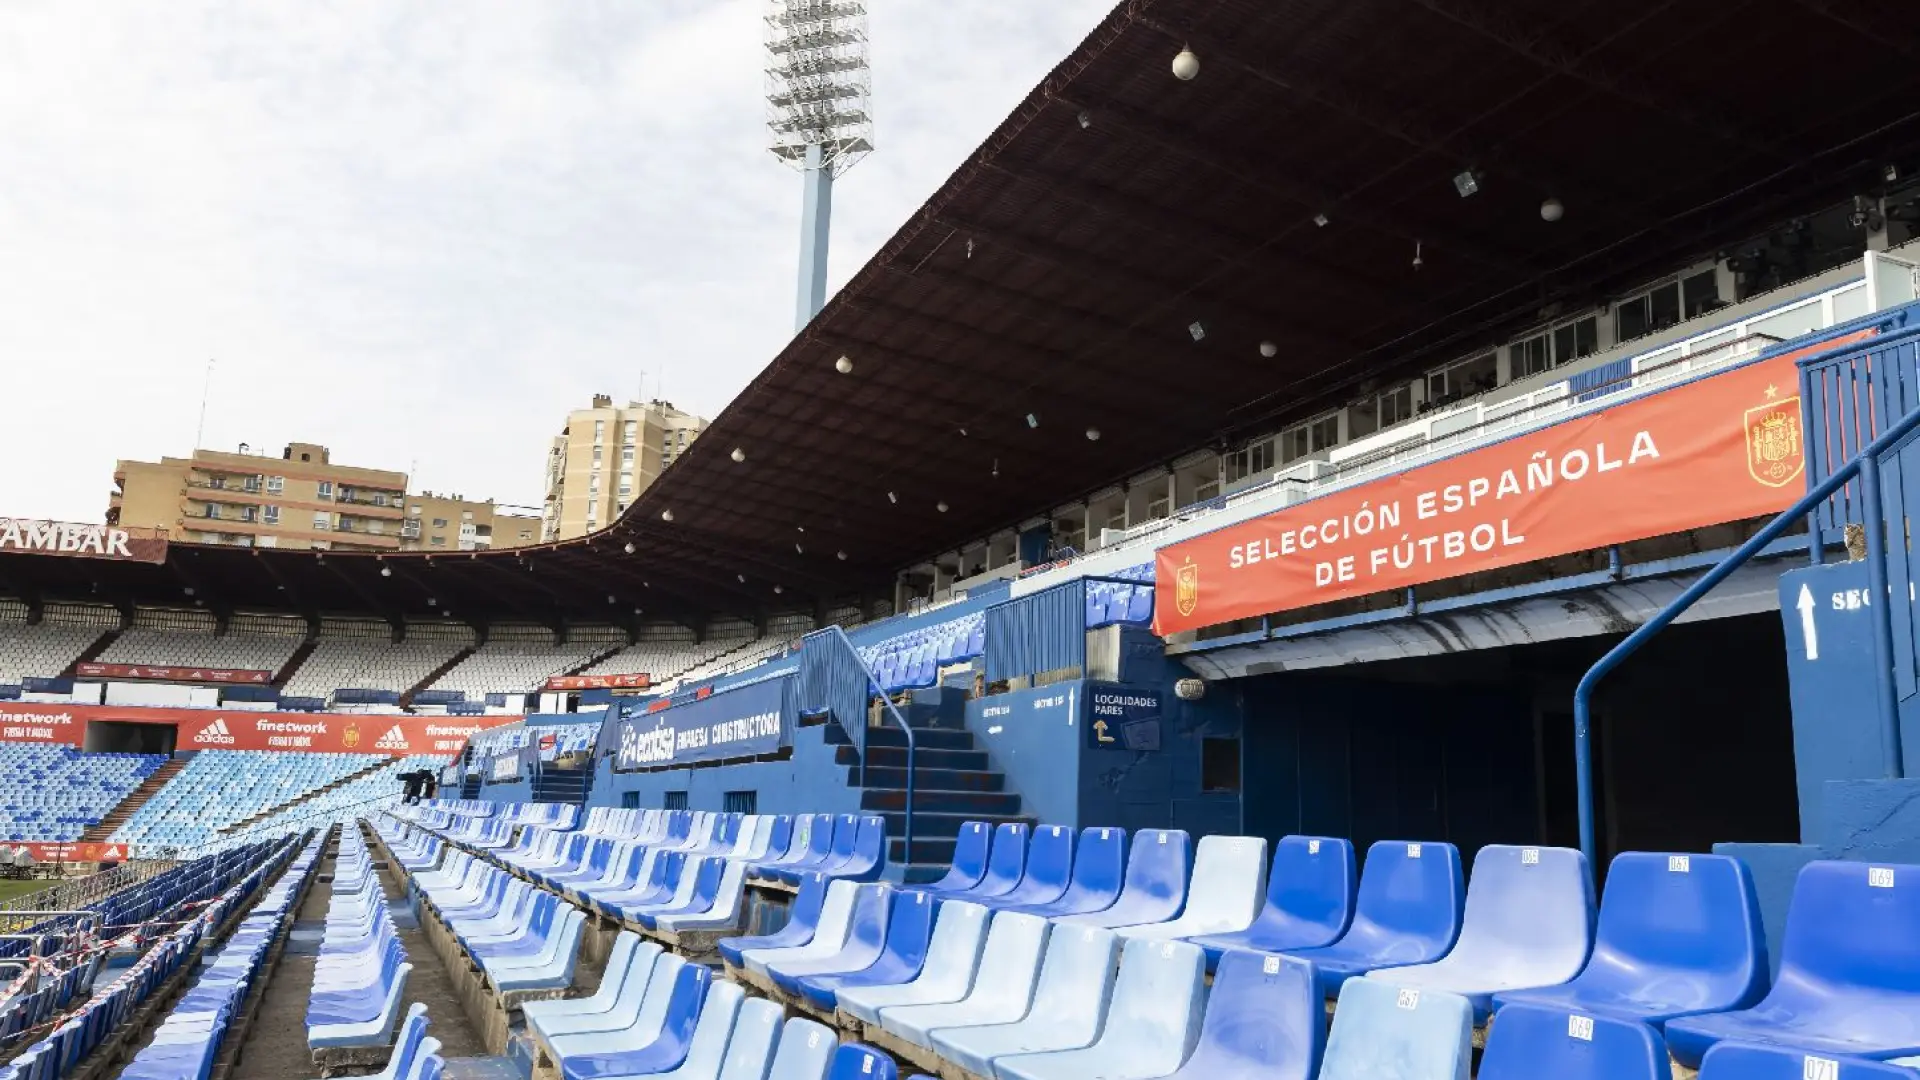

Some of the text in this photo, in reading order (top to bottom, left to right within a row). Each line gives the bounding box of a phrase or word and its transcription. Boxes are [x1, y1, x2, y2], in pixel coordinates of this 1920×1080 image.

[1230, 431, 1660, 569] SELECCIÓN ESPAÑOLA
[0, 520, 132, 557] AMBAR
[1316, 518, 1525, 587] DE FÚTBOL
[1094, 693, 1158, 708] LOCALIDADES
[0, 709, 72, 724] inetwork
[1094, 705, 1123, 716] PARES
[256, 718, 327, 734] finetwork
[677, 726, 709, 751] EMPRESA
[712, 710, 781, 745] CONSTRUCTORA
[194, 734, 235, 744] adidas
[374, 740, 409, 749] adidas
[1670, 857, 1688, 870] 067
[1870, 869, 1893, 886] 069
[1570, 1018, 1591, 1038] 069
[1806, 1059, 1834, 1080] 071
